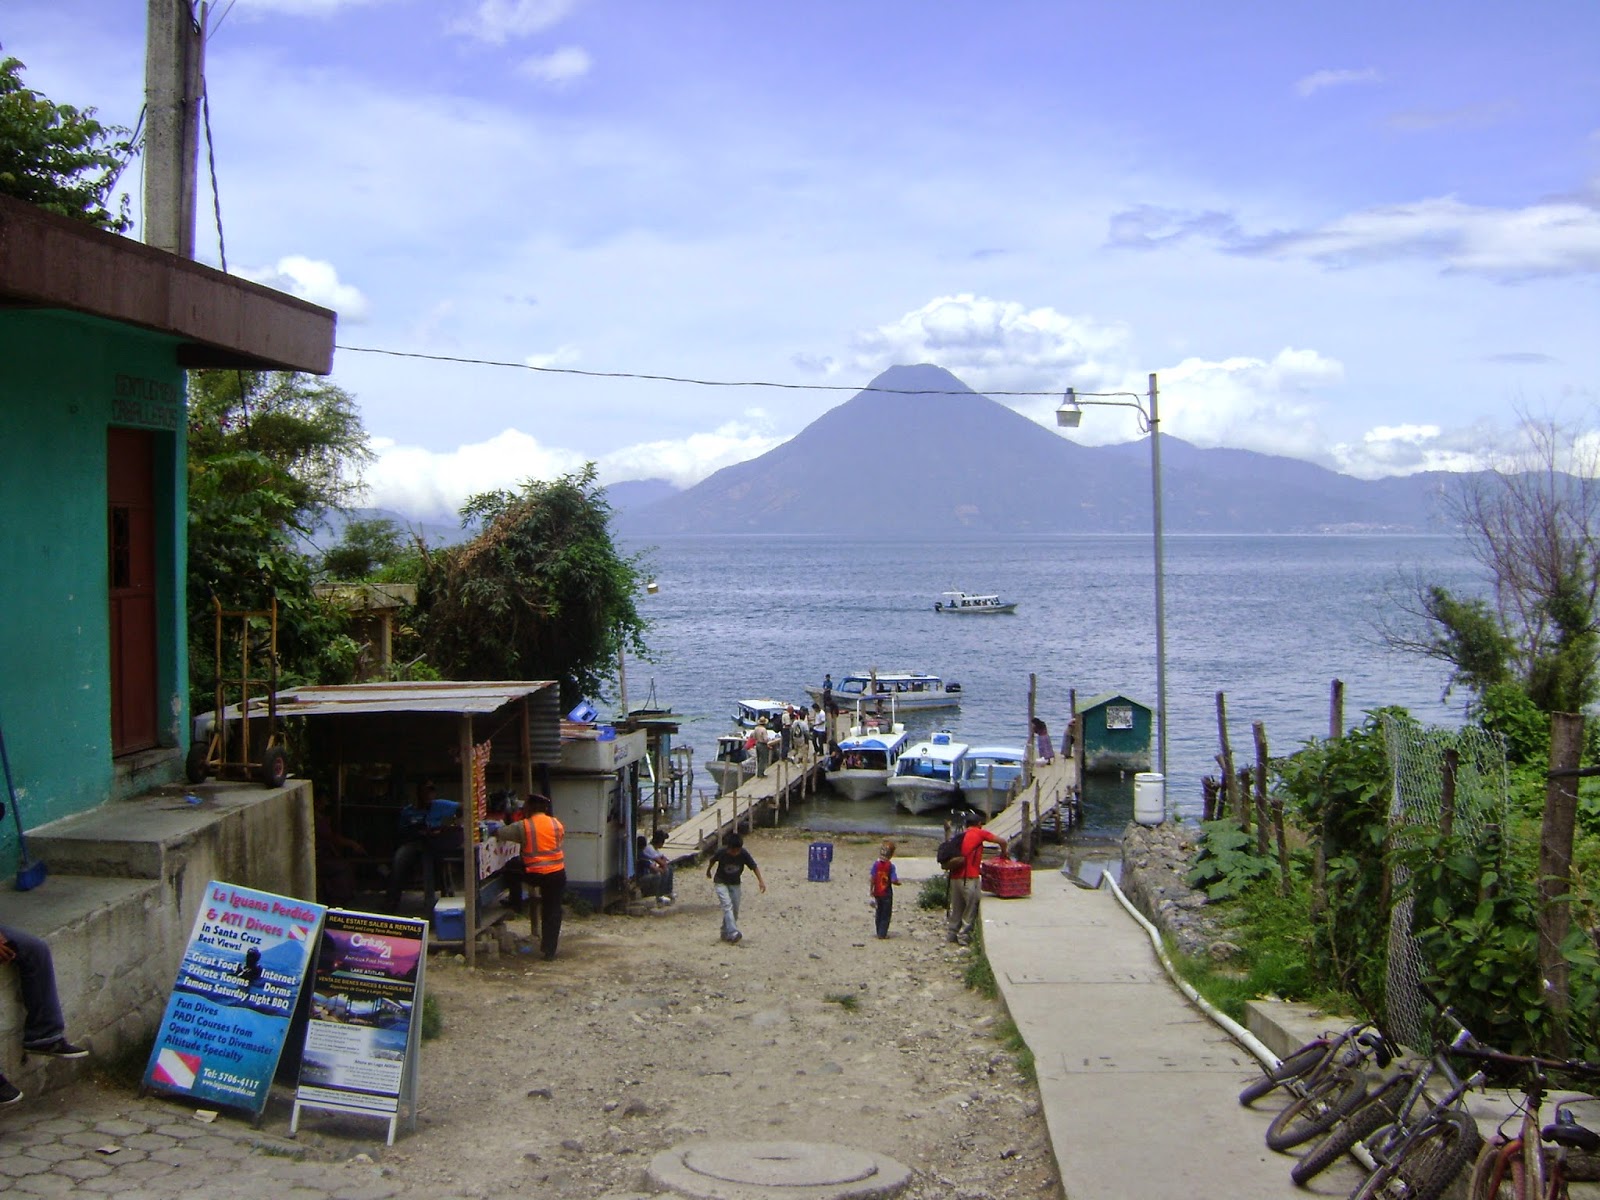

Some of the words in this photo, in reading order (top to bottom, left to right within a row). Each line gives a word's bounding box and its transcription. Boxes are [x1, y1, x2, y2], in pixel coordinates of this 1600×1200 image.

[212, 888, 226, 902] La
[230, 891, 268, 912] Iguana
[272, 902, 316, 922] Perdida
[202, 922, 210, 933] in
[213, 925, 238, 939] Santa
[240, 932, 262, 945] Cruz
[206, 908, 218, 920] &
[220, 911, 243, 927] ATI
[245, 917, 283, 937] Divers
[329, 915, 345, 924] REAL
[346, 917, 368, 926] ESTATE
[369, 920, 388, 929] SALES
[394, 923, 422, 932] RENTALS
[198, 933, 214, 944] Best
[218, 938, 242, 951] Views!
[350, 933, 386, 950] Century
[380, 945, 392, 958] 21
[192, 952, 216, 966] Great
[218, 959, 239, 974] Food
[188, 963, 219, 980] Private
[219, 971, 249, 988] Rooms
[260, 968, 297, 986] Internet
[183, 976, 212, 992] Famous
[214, 983, 249, 1001] Saturday
[249, 993, 270, 1007] night
[271, 998, 290, 1010] BBQ
[263, 982, 291, 998] Dorms
[176, 998, 193, 1010] Fun
[195, 1002, 219, 1016] Dives
[173, 1010, 196, 1023] PADI
[197, 1017, 231, 1032] Courses
[232, 1025, 253, 1037] from
[165, 1034, 201, 1051] Altitude
[203, 1042, 243, 1063] Specialty
[169, 1022, 190, 1035] Open
[193, 1026, 217, 1041] Water
[218, 1034, 227, 1044] to
[228, 1037, 274, 1055] Divemaster
[203, 1068, 217, 1079] Tel:
[218, 1071, 260, 1089] 5706-4117
